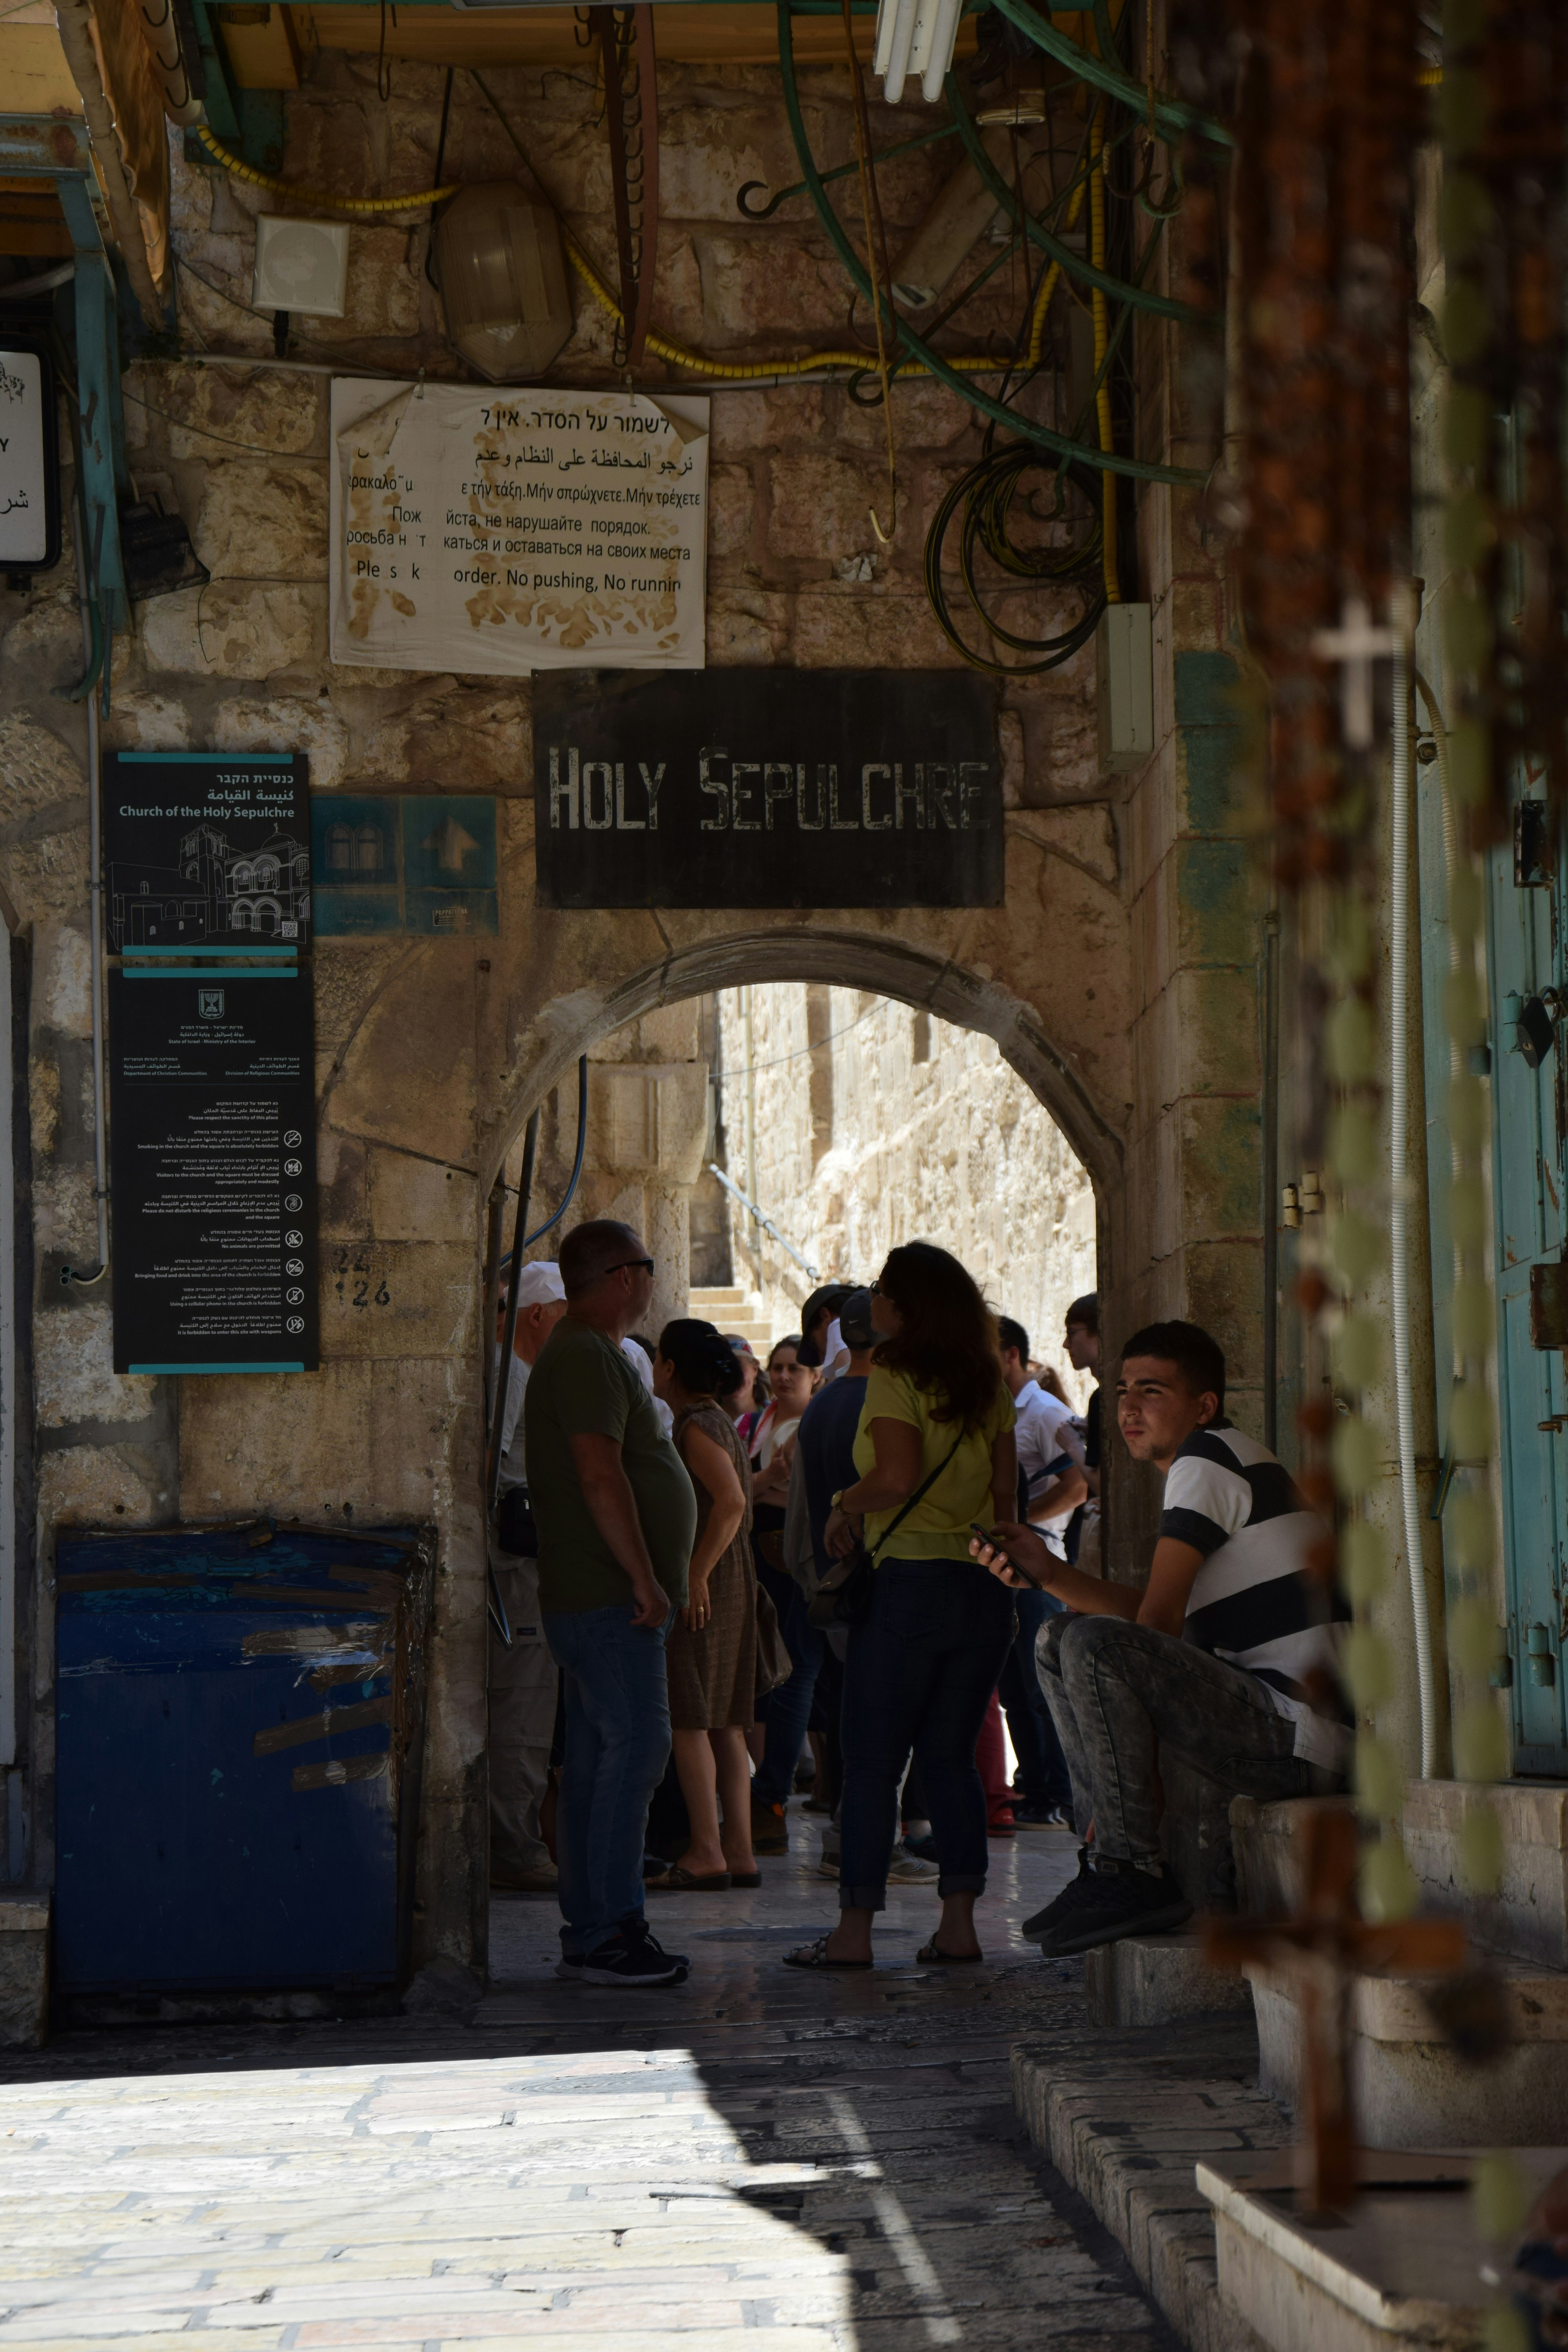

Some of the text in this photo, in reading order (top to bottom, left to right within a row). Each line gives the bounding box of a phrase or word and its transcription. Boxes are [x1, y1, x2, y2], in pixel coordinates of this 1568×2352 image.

[497, 410, 519, 431] אין
[526, 412, 580, 429] הסדר.
[586, 409, 608, 432] על
[515, 445, 553, 470] النظام
[559, 448, 586, 471] على
[591, 449, 650, 468] المحافظة
[486, 515, 502, 527] не
[506, 515, 582, 533] нарушайте
[591, 521, 650, 537] порядок.
[493, 540, 500, 551] и
[505, 540, 582, 555] оставаться
[587, 544, 603, 556] на
[608, 545, 646, 558] своих
[454, 567, 501, 584] order.
[507, 570, 528, 586] No
[534, 571, 598, 593] pushing,
[604, 574, 626, 590] No
[217, 775, 294, 784] כנסיית הקבר
[549, 746, 990, 830] HOLY SEPULCHRE
[208, 789, 294, 804] كنيسة القيامة
[120, 806, 294, 819] Church of the Holy Sepulchre
[335, 1281, 390, 1306] 126
